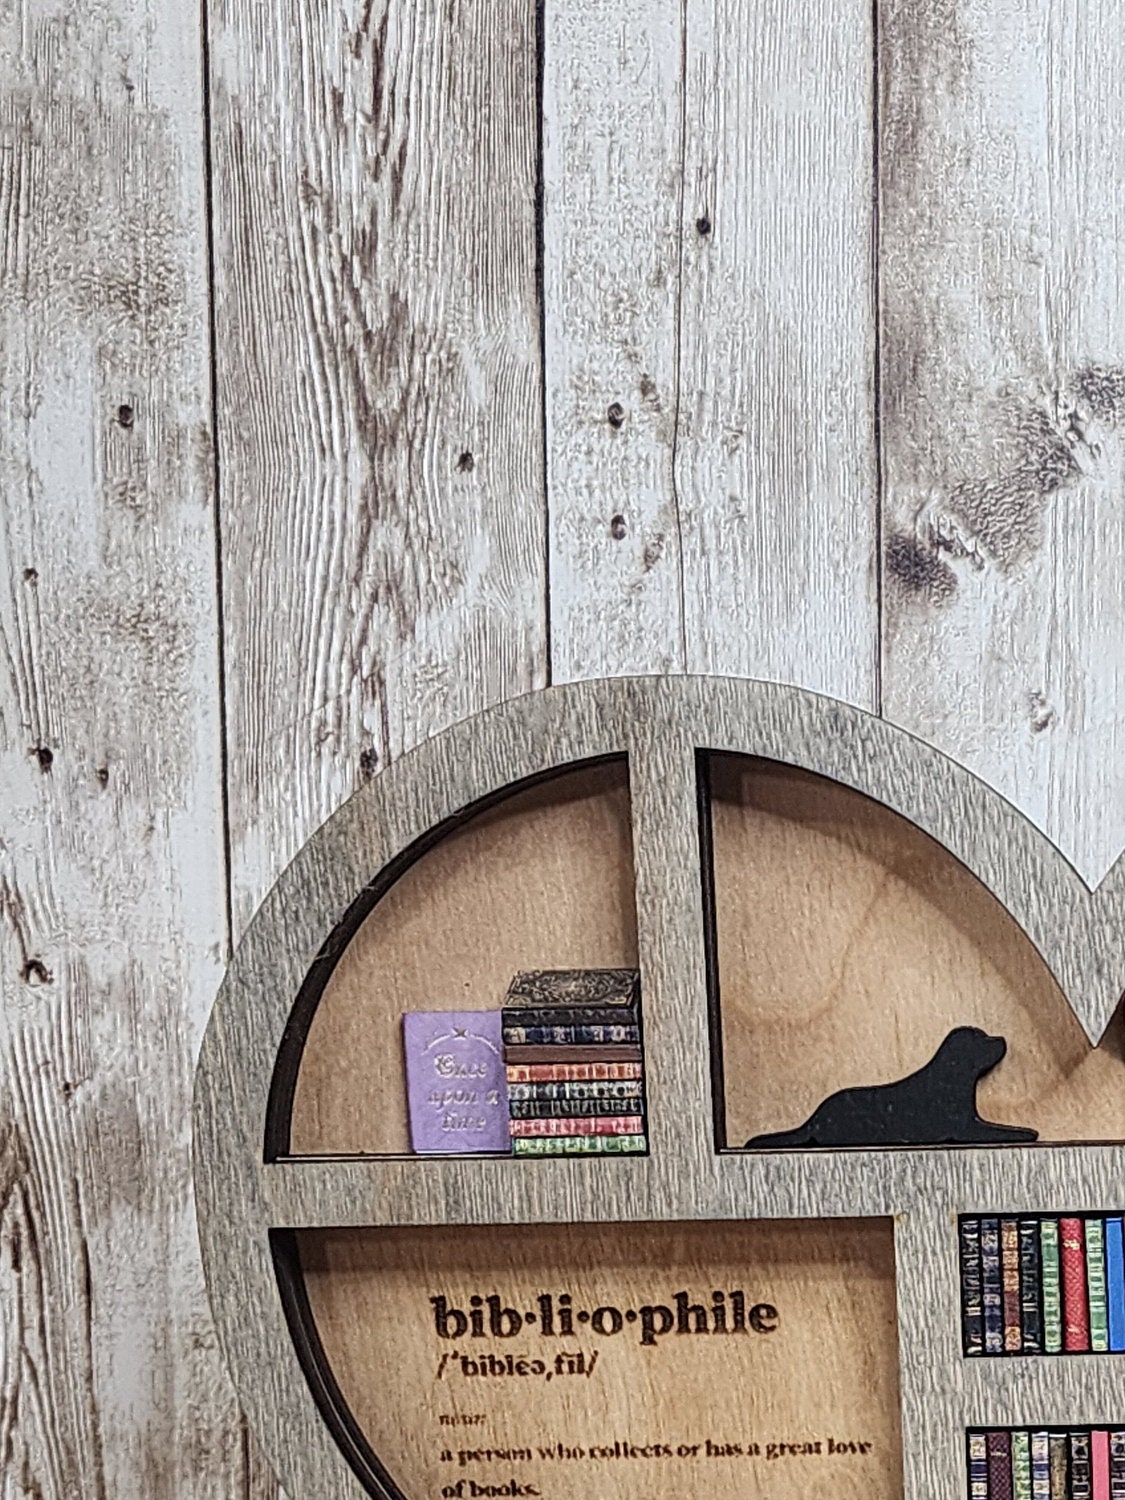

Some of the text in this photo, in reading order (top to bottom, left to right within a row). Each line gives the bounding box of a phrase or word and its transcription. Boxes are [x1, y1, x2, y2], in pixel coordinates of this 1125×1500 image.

[440, 1438, 873, 1467] a person who collects or has a great love
[441, 1479, 467, 1498] of
